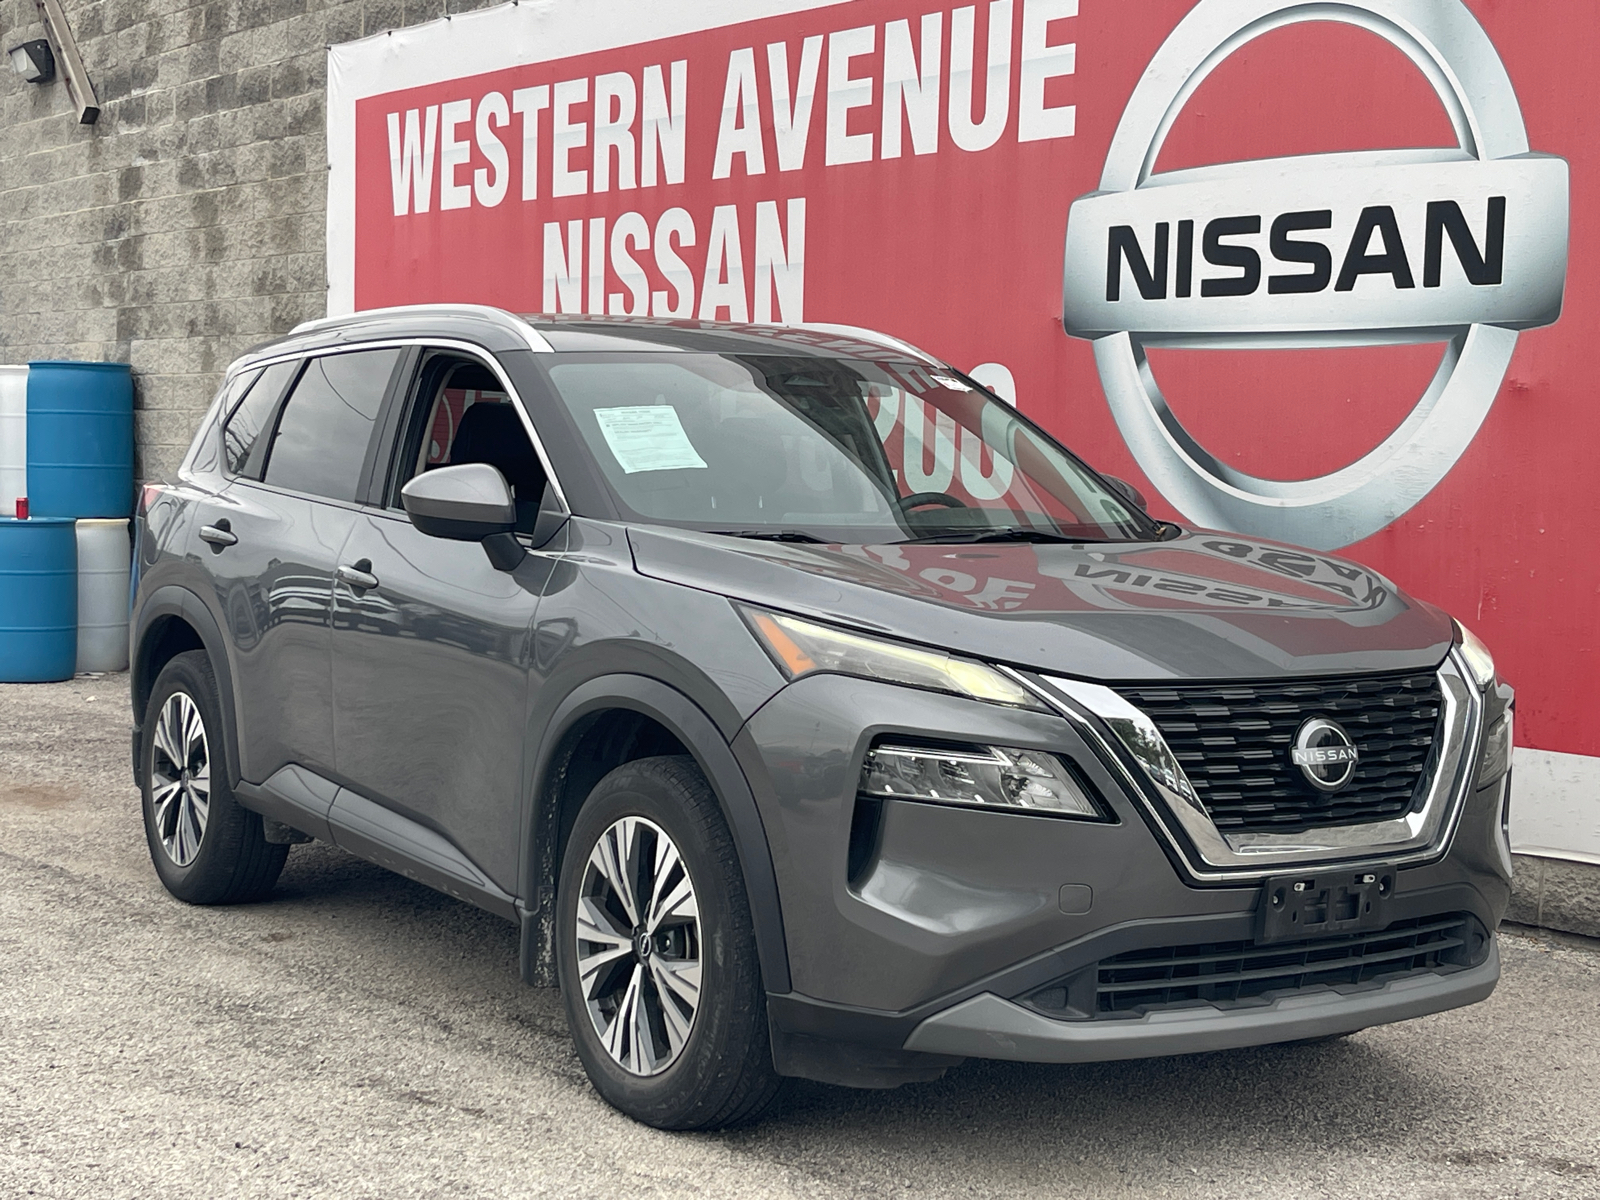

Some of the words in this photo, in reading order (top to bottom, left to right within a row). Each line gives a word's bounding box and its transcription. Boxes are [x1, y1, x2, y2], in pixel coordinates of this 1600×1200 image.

[387, 60, 687, 217] WESTERN
[712, 0, 1080, 180] AVENUE
[542, 197, 806, 324] NISSAN
[1105, 195, 1507, 302] NISSAN
[1294, 747, 1357, 763] NISSAN
